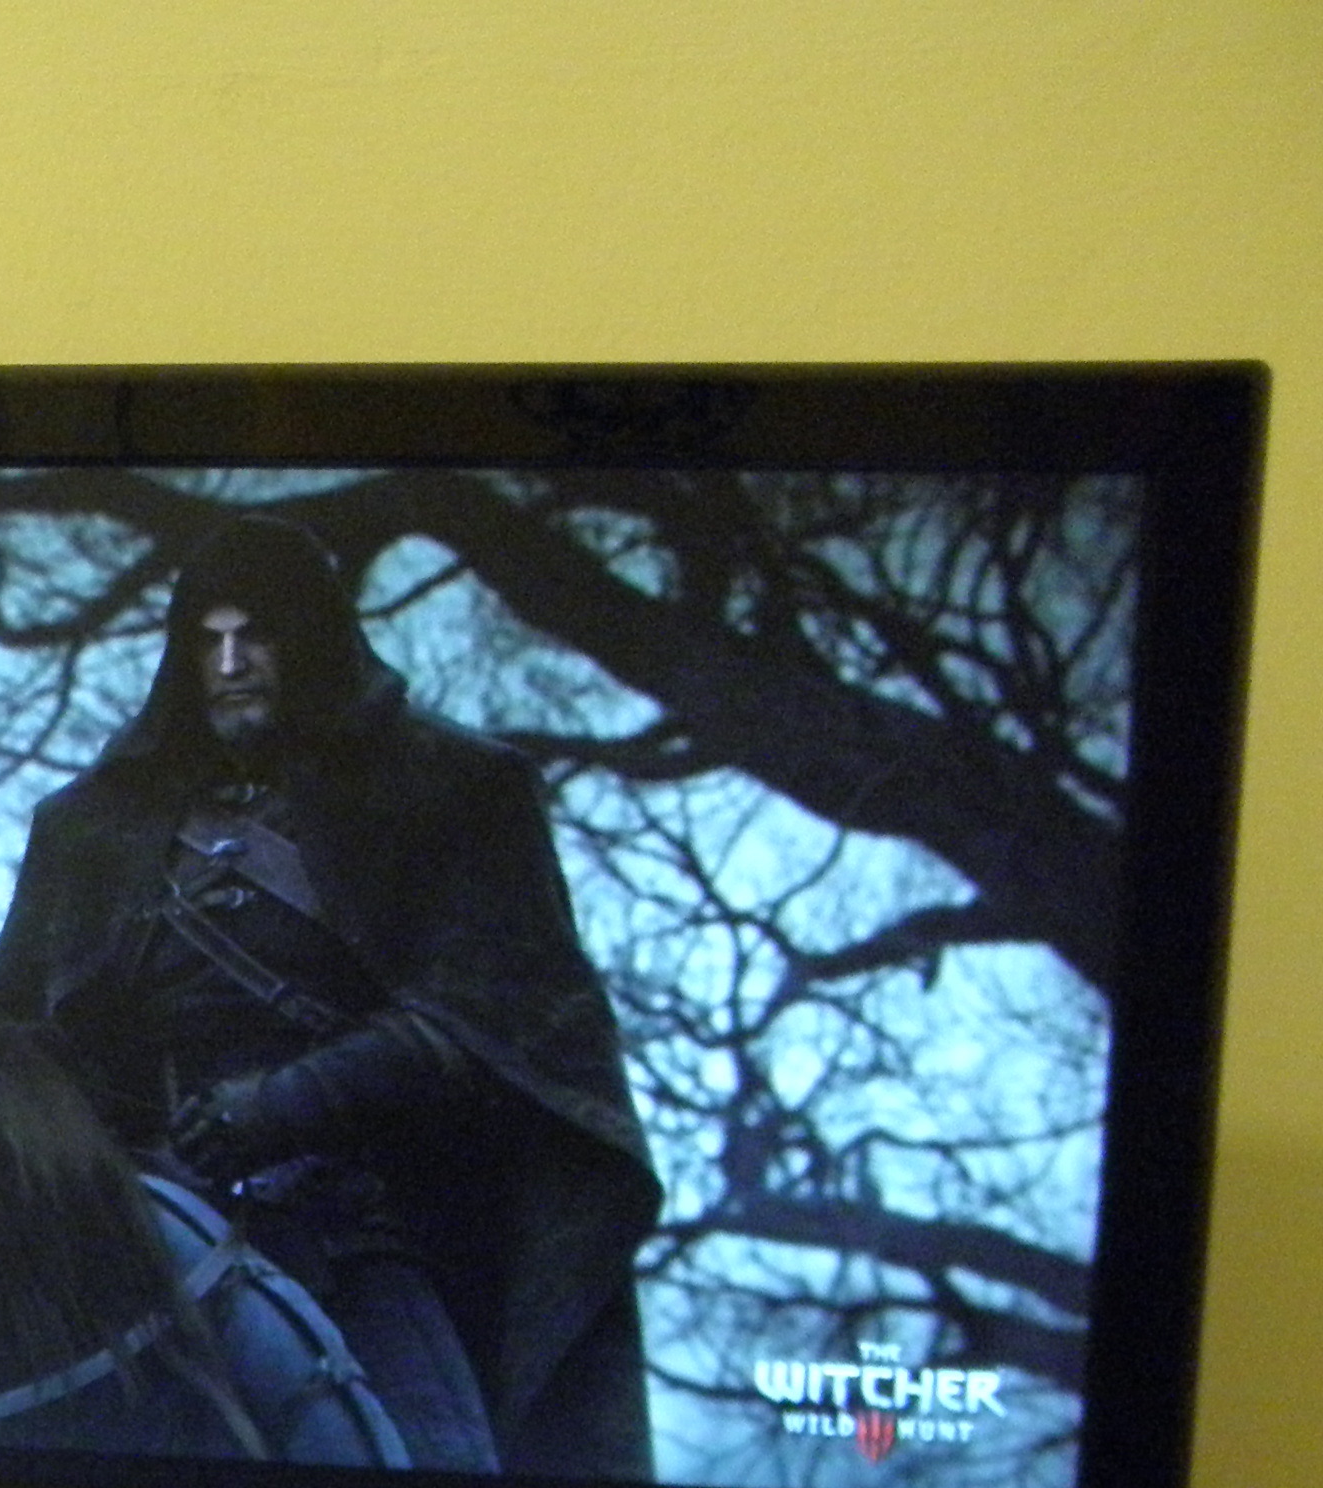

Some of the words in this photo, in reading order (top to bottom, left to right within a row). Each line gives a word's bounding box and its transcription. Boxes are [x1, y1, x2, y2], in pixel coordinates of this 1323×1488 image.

[857, 1341, 902, 1362] THE
[754, 1360, 1008, 1419] WITCHER
[782, 1411, 856, 1438] WILD
[896, 1417, 975, 1442] HUNT
